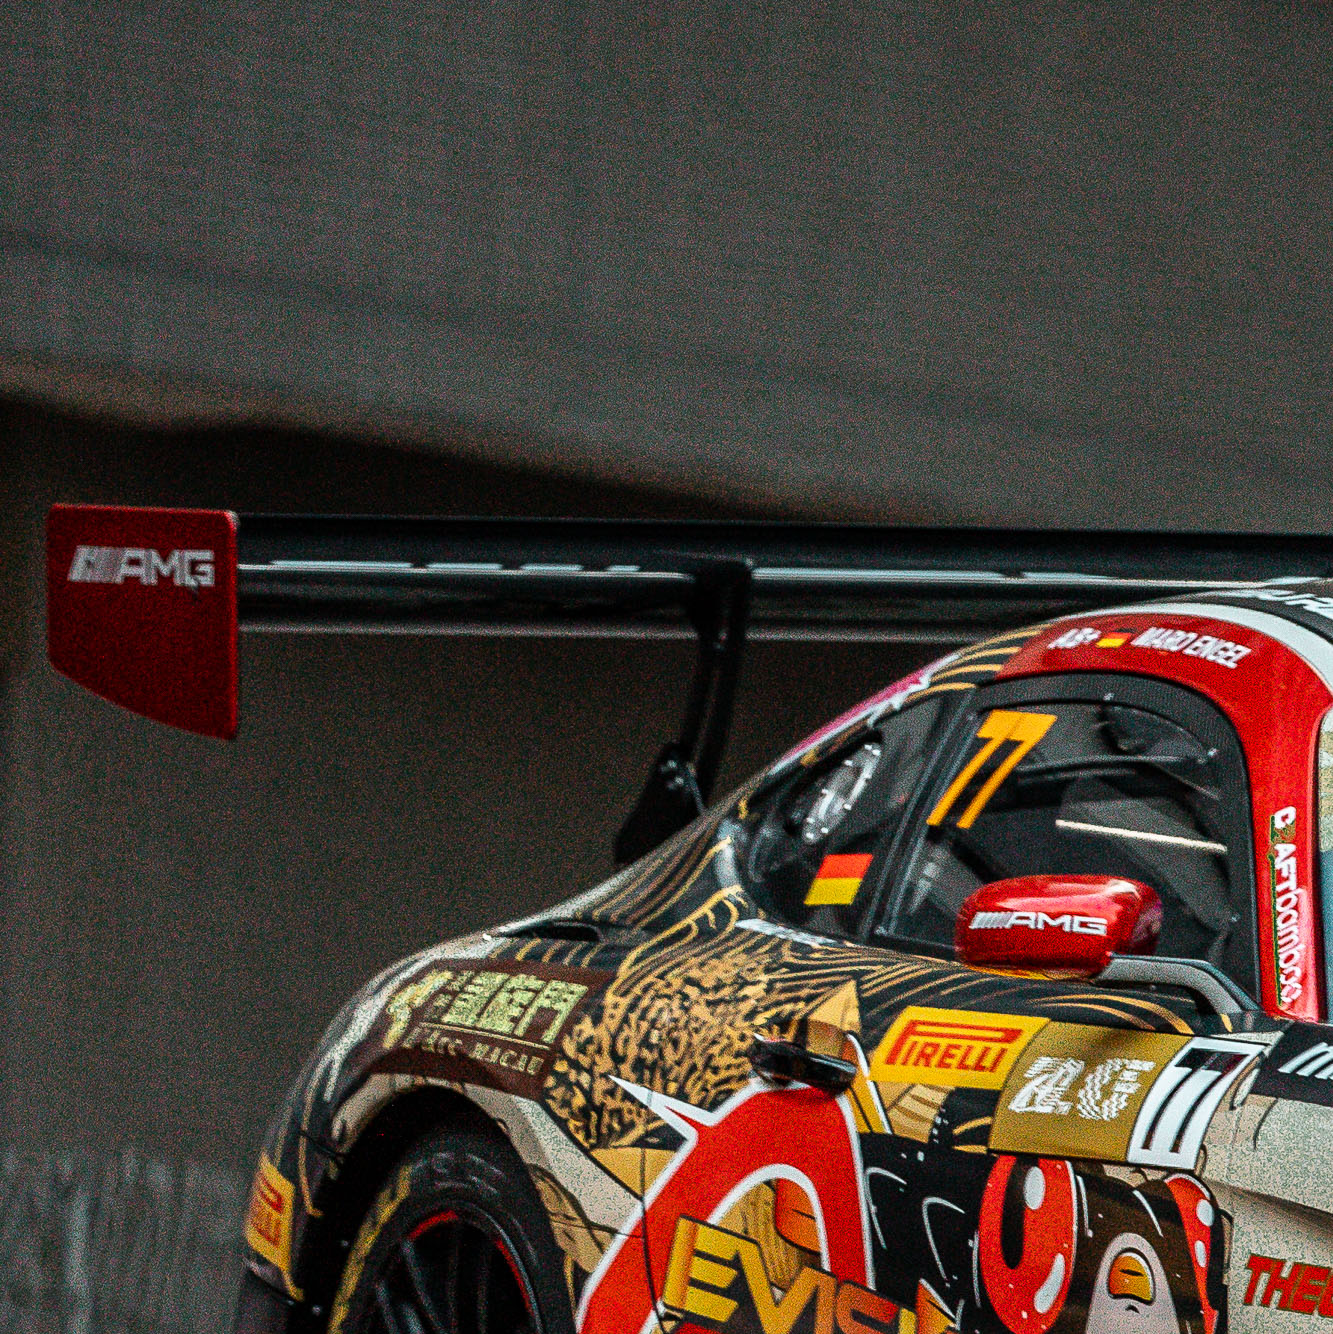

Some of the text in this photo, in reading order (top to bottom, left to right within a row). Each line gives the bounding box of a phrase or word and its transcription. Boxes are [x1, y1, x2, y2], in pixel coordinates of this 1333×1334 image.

[117, 548, 216, 587] AMG
[1182, 634, 1253, 670] ENGEL
[927, 710, 1058, 829] 77
[1006, 911, 1108, 936] AMG
[885, 1019, 1024, 1073] PIRELLI
